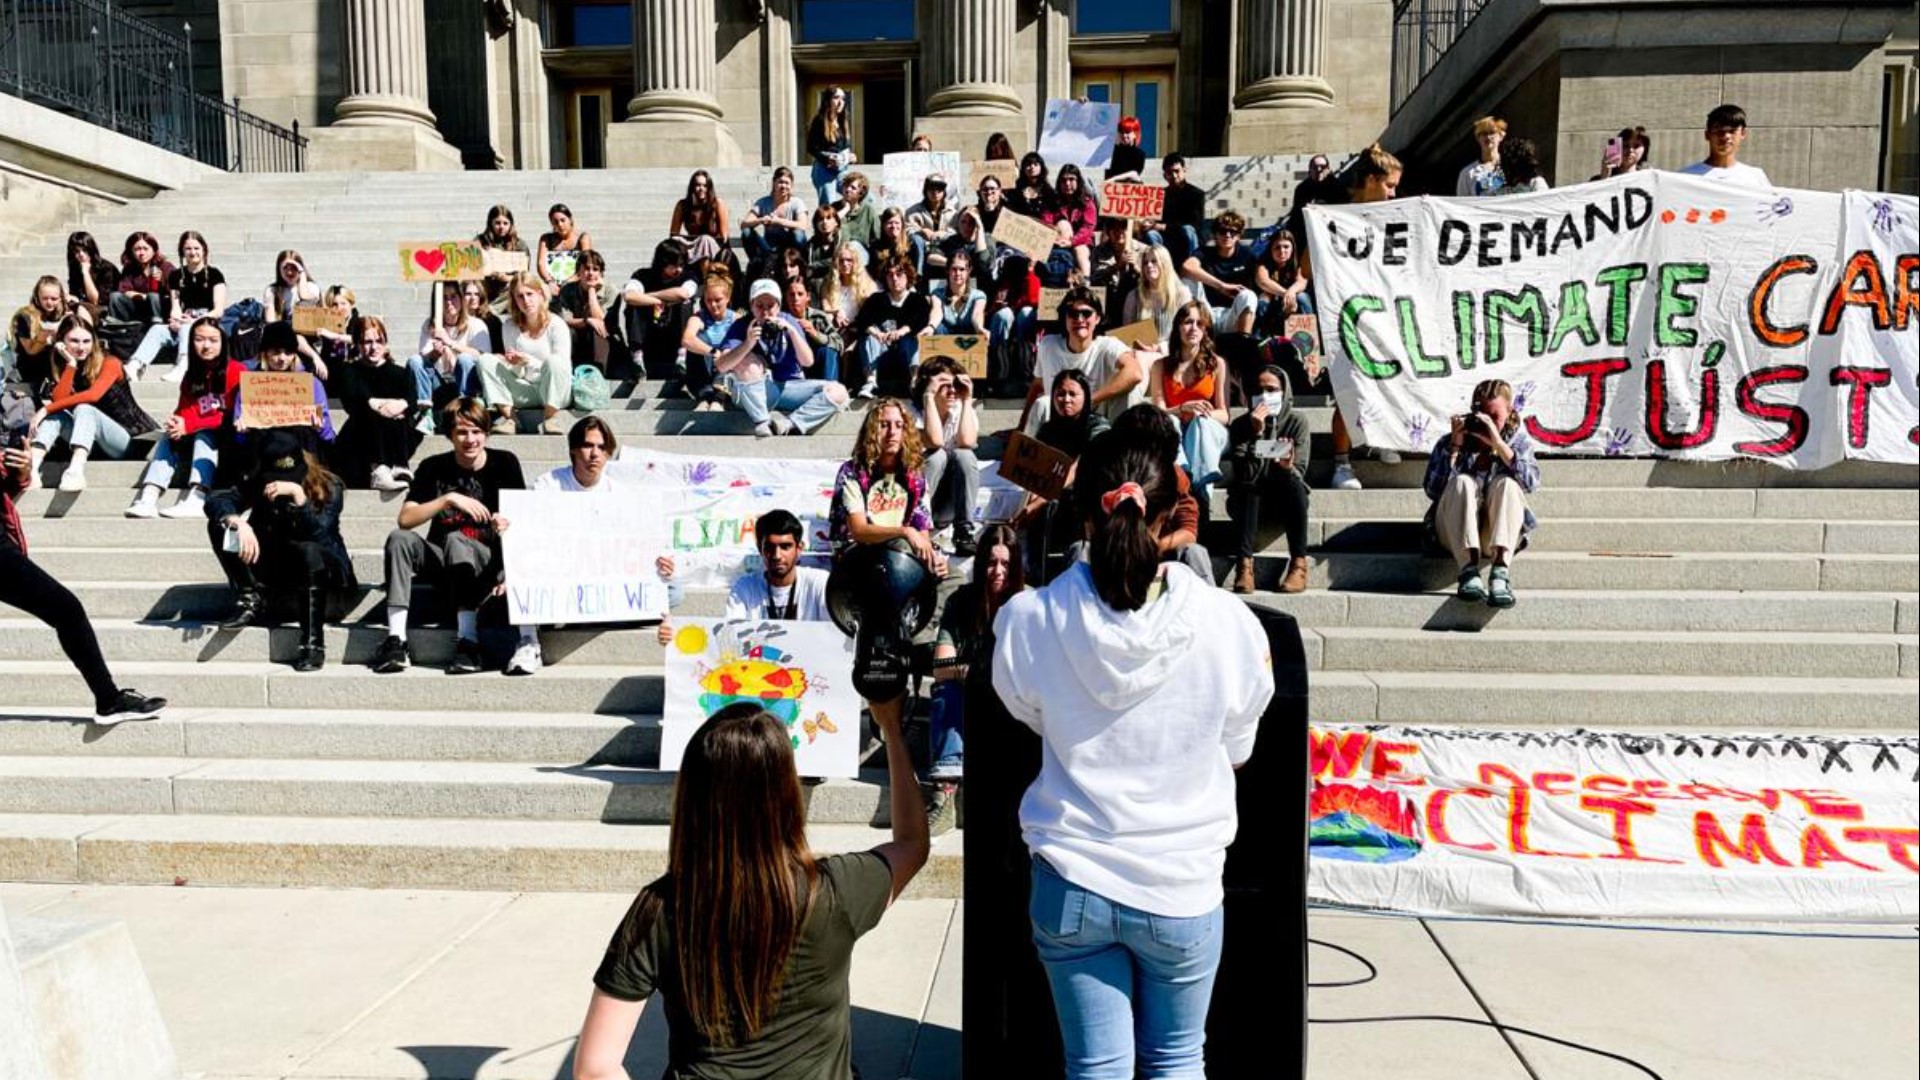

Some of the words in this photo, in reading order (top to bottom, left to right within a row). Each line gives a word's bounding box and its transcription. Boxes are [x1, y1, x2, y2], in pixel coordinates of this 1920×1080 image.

[1104, 183, 1164, 200] CLIMATE
[1327, 220, 1409, 266] WE
[1523, 357, 1919, 457] JUST
[1309, 729, 1426, 786] WE
